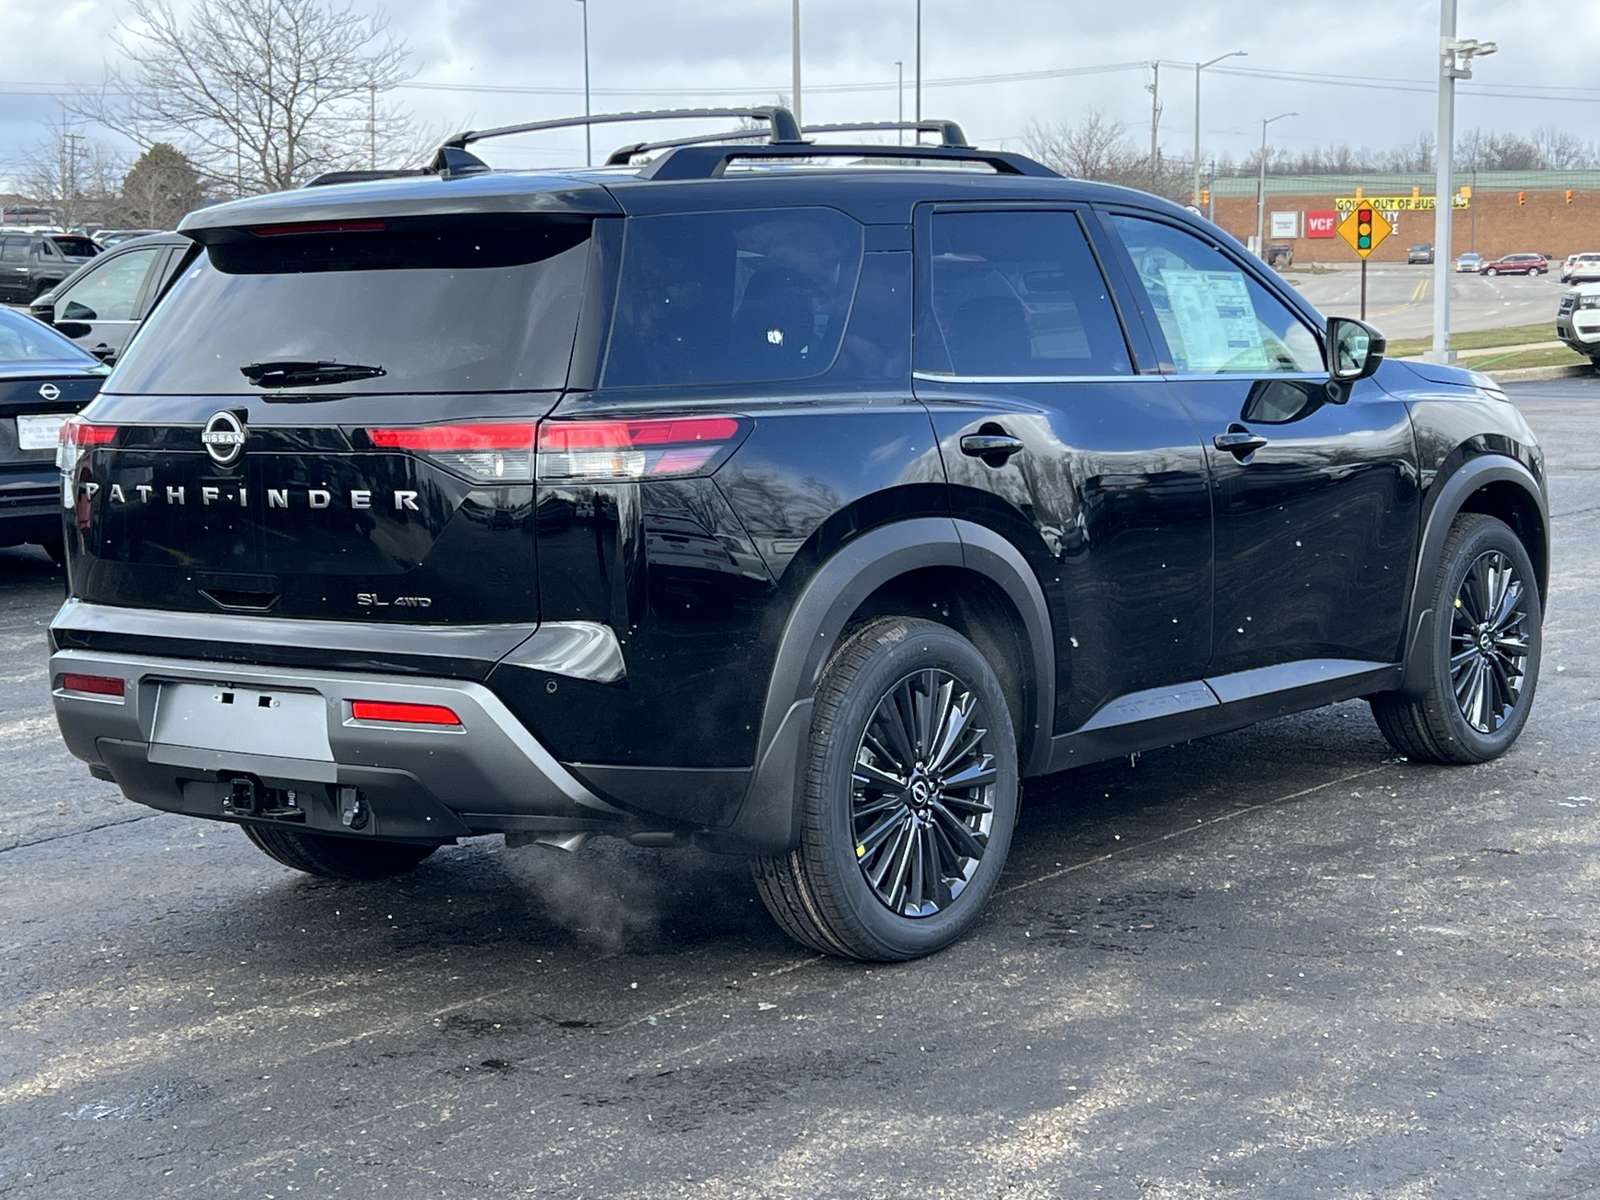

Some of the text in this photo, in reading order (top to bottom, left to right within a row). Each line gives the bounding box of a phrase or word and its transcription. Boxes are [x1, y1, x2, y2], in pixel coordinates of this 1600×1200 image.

[1374, 199, 1394, 209] OUT
[1398, 199, 1411, 209] OF
[1309, 217, 1334, 231] VCF
[202, 434, 243, 443] NISSAN
[84, 482, 420, 511] PATHFINDER
[356, 593, 432, 607] SL 4WD
